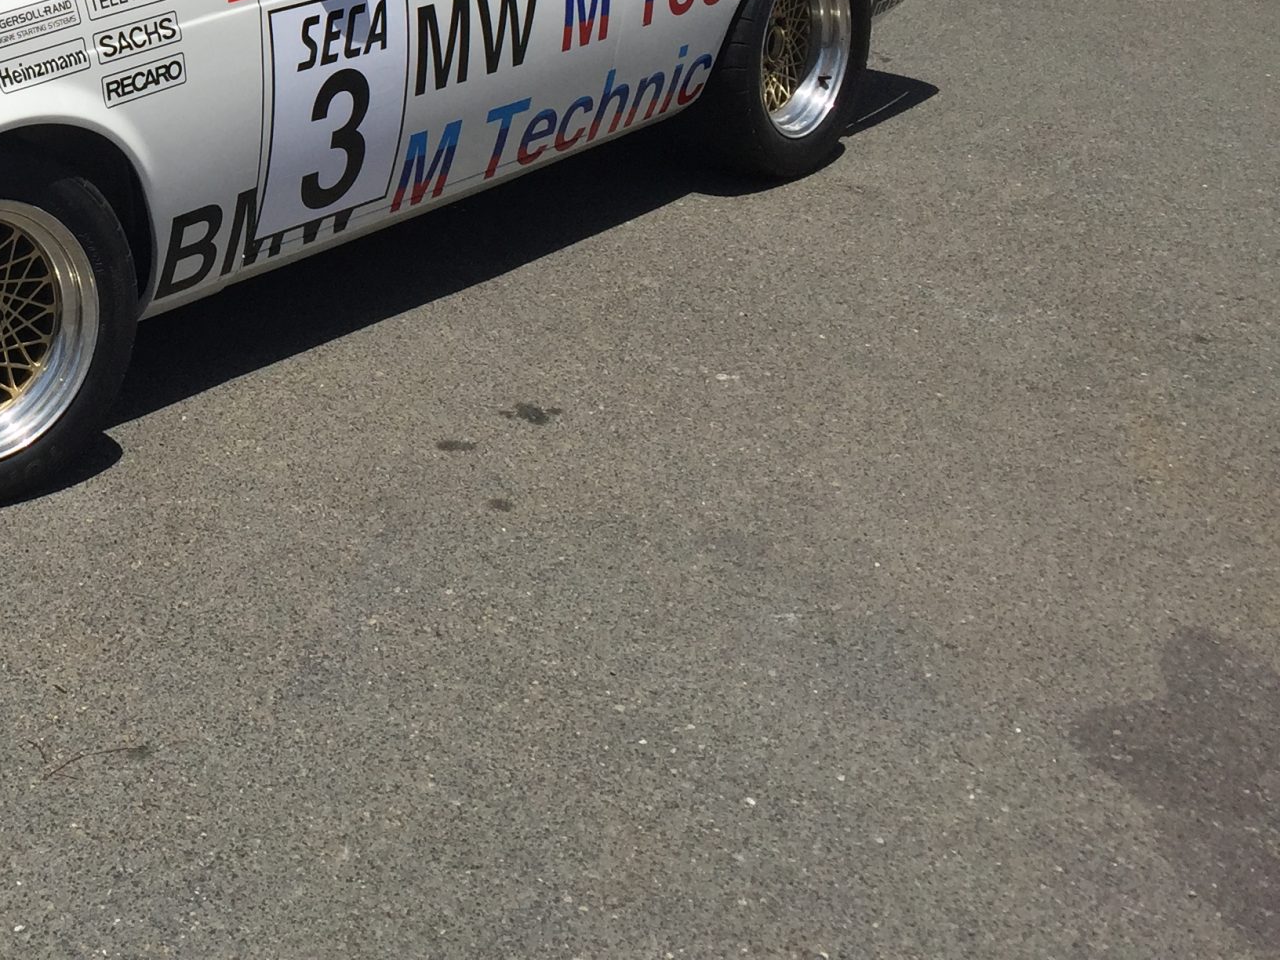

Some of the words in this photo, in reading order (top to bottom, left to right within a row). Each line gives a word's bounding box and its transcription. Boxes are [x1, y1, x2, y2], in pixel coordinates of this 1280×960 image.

[16, 22, 48, 39] STARTING
[99, 17, 177, 58] SACHS
[105, 60, 183, 101] RECARO
[300, 67, 371, 210] 3
[389, 119, 463, 213] M
[482, 44, 714, 180] Technic
